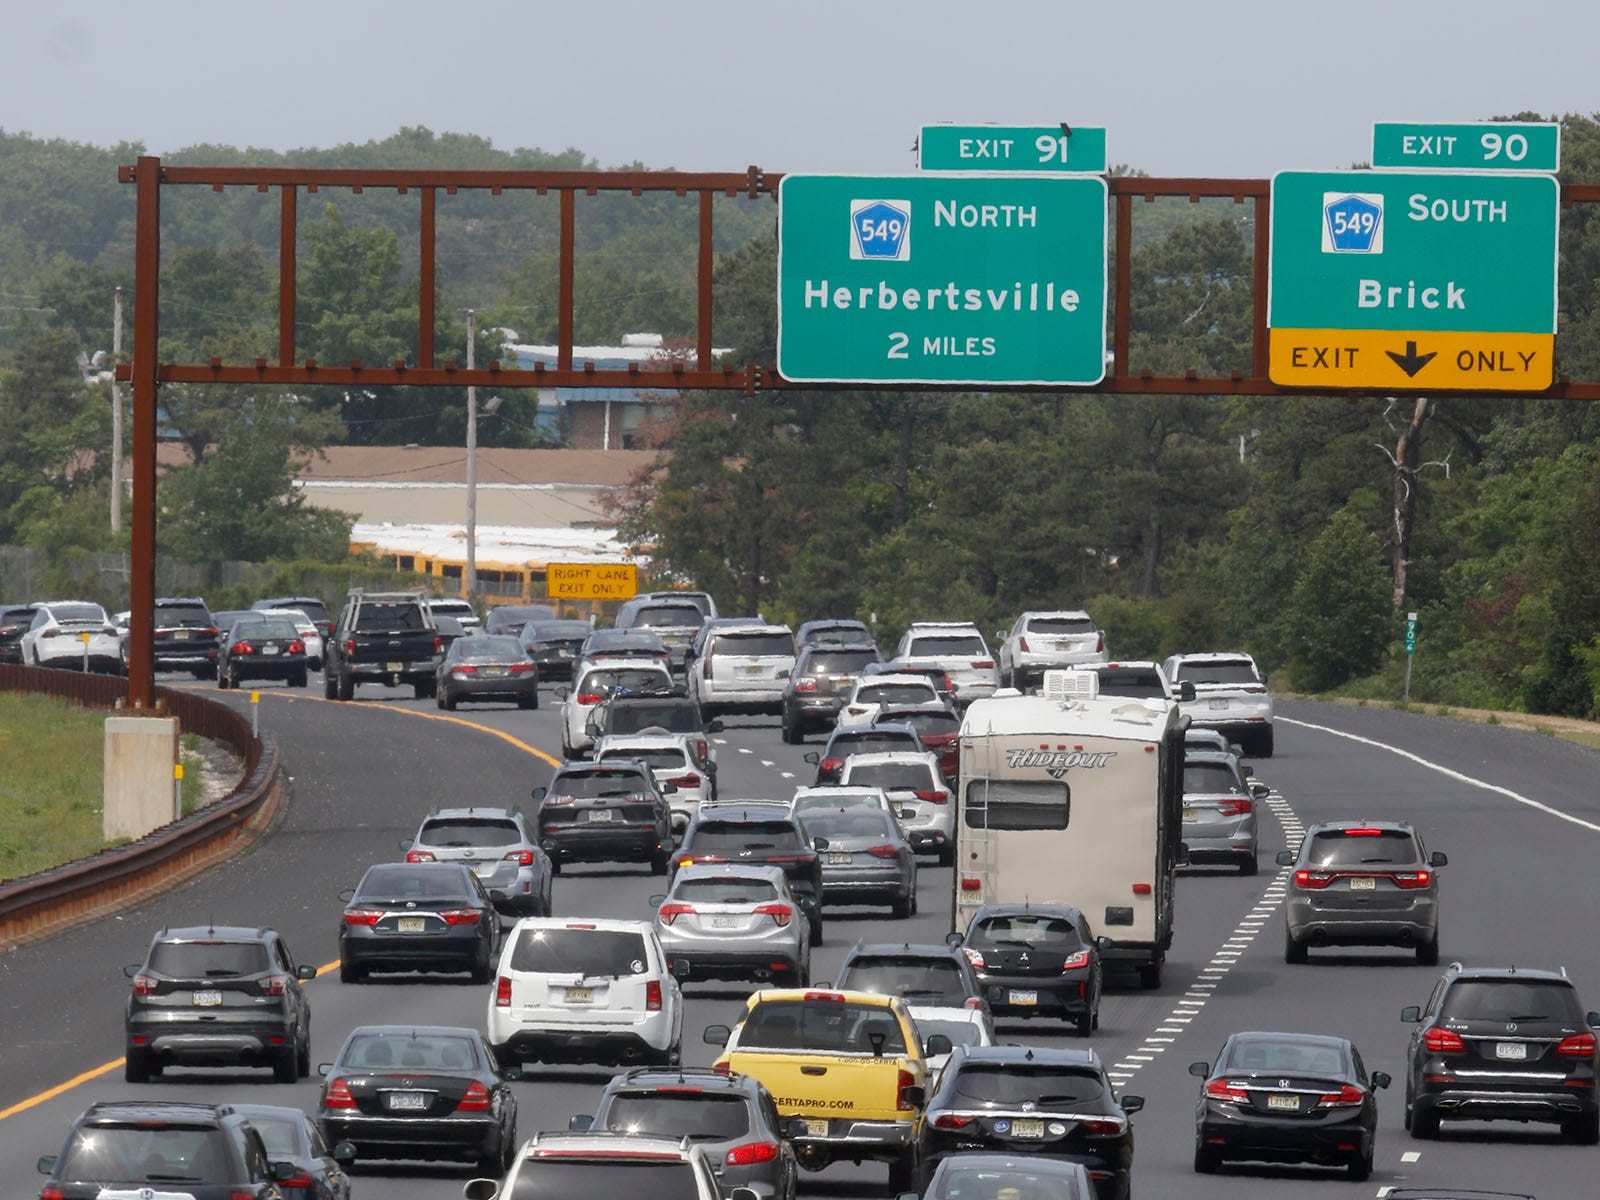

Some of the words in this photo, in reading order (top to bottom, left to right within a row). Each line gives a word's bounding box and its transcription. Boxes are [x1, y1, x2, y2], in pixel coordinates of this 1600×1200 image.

[958, 139, 1015, 159] EXIT
[1034, 135, 1069, 164] 91
[1402, 136, 1458, 155] EXIT
[1480, 132, 1529, 162] 90
[933, 199, 1038, 228] NORTH
[1407, 193, 1508, 223] SOUTH
[861, 218, 902, 242] 549
[1333, 211, 1375, 235] 549
[804, 279, 1081, 313] Herbertsville
[1357, 279, 1467, 311] Brick
[887, 332, 910, 360] 2
[923, 336, 997, 357] MILES
[1291, 347, 1360, 369] EXIT
[1456, 350, 1537, 373] ONLY
[554, 568, 592, 579] RIGHT
[597, 570, 629, 580] LANE
[558, 583, 585, 593] EXIT
[592, 583, 625, 594] ONLY
